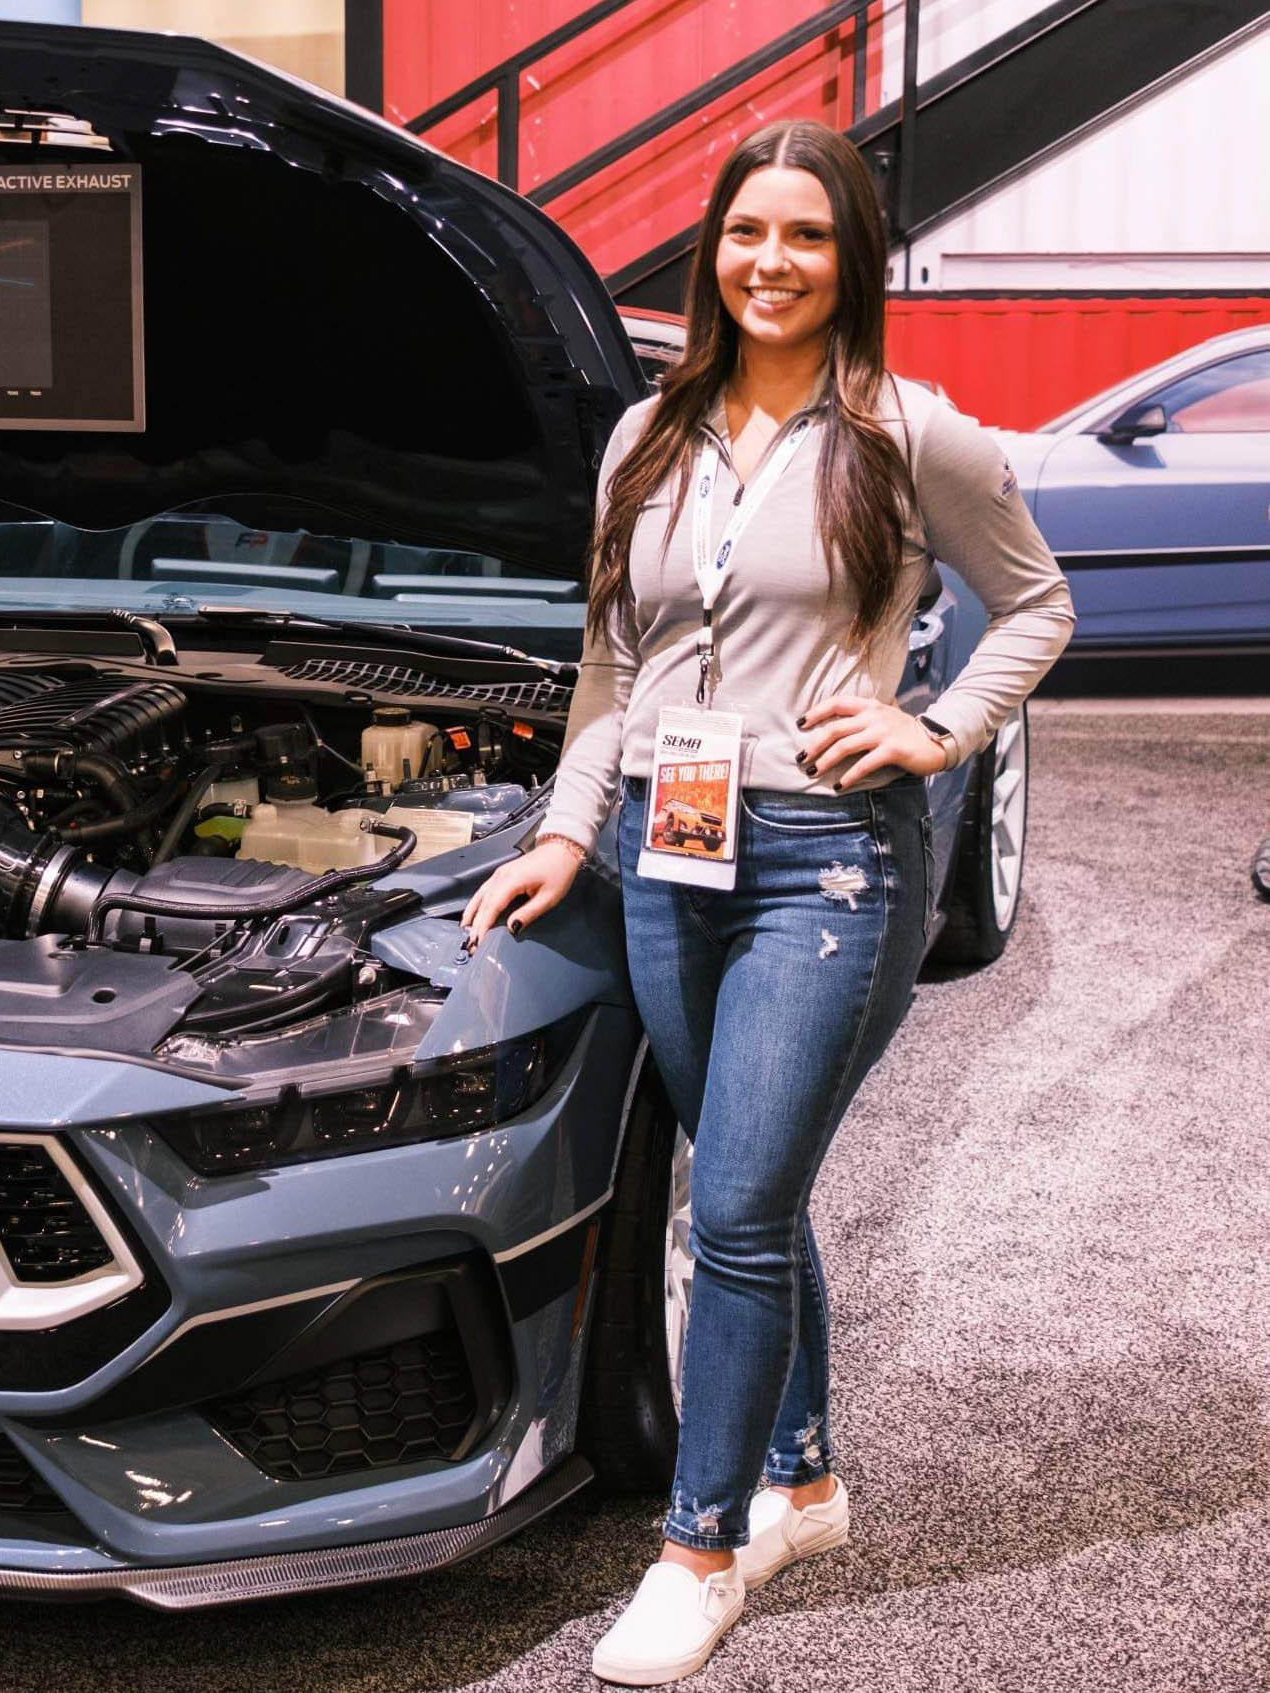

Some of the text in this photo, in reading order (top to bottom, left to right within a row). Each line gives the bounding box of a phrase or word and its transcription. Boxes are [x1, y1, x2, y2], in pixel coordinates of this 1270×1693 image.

[55, 174, 132, 189] EXHAUST
[662, 734, 702, 750] SEMA
[659, 762, 730, 784] SEE YOU THERE!
